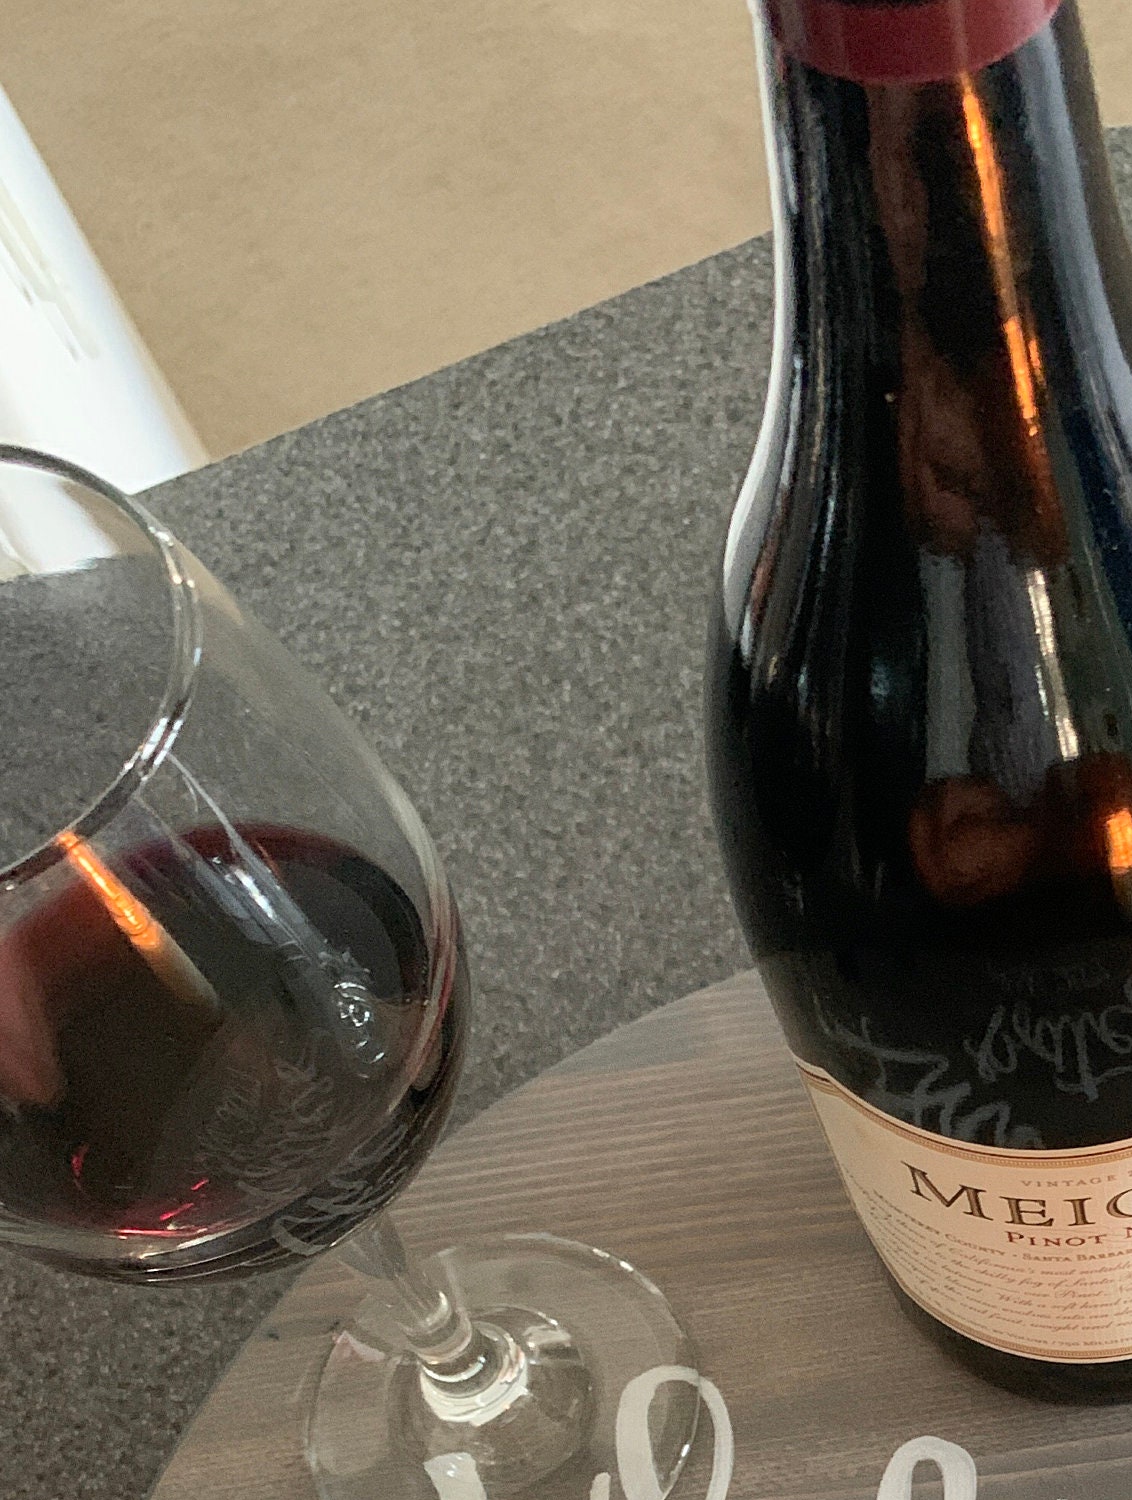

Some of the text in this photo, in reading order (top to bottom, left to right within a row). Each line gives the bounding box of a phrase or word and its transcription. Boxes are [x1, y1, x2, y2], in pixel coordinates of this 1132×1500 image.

[1021, 1174, 1118, 1188] VINTAGE
[945, 1232, 1007, 1257] COUNTY
[1022, 1252, 1073, 1262] SANTA
[1004, 1230, 1108, 1248] PINOT
